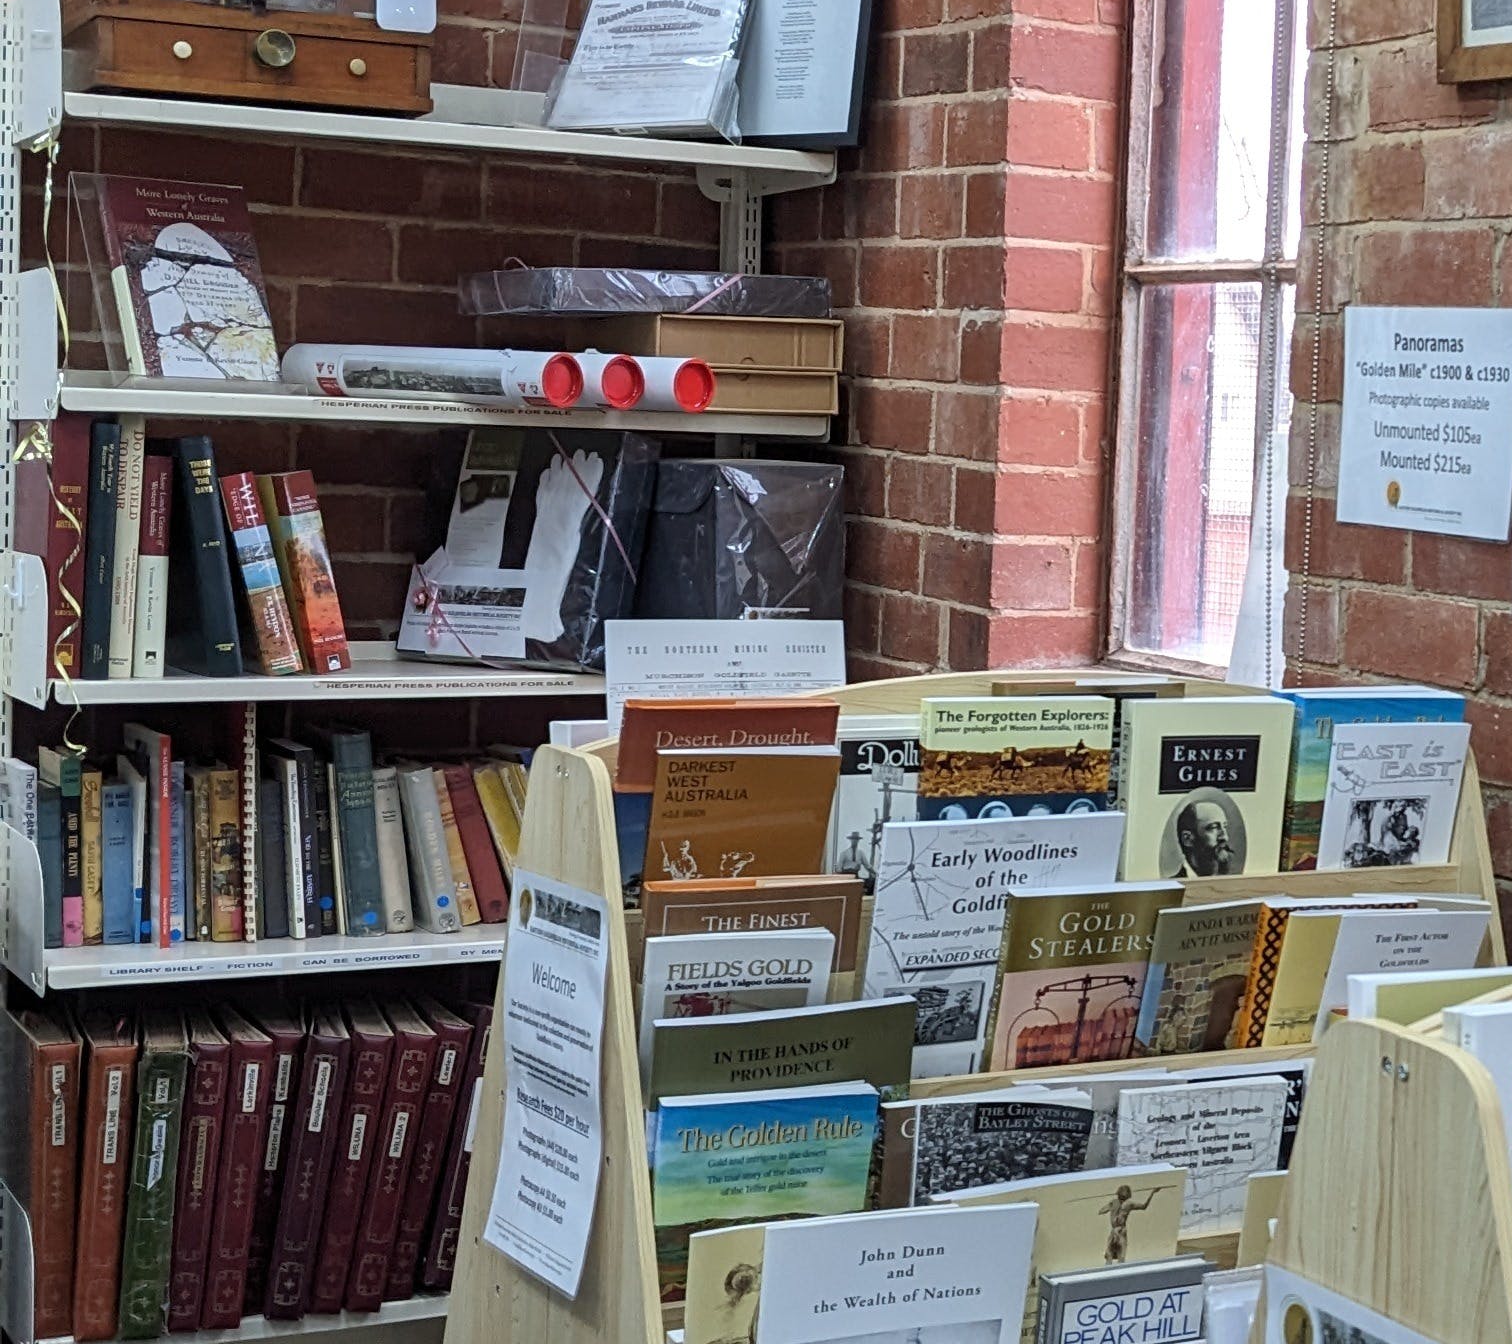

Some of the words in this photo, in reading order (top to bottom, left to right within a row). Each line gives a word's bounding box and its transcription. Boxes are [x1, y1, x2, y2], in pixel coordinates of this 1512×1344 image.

[147, 208, 184, 219] Western
[1394, 333, 1464, 352] Panoramas
[1430, 366, 1461, 380] c1900
[1466, 368, 1473, 380] &
[1478, 368, 1510, 382] c1930
[433, 406, 514, 415] PUBLICATIONS
[134, 431, 143, 454] DO
[1374, 421, 1439, 442] Unmounted
[1442, 424, 1480, 444] $105ea
[132, 456, 141, 482] NOT
[1380, 451, 1430, 472] Mounted
[1434, 454, 1471, 475] $215ea
[117, 455, 127, 510] DESPAIR
[130, 485, 139, 520] YIELD
[936, 710, 963, 722] The
[968, 710, 1036, 724] Forgotten
[1041, 709, 1109, 722] Explorers:
[1172, 745, 1247, 762] ERNEST
[669, 760, 736, 774] DARKEST
[1179, 766, 1238, 781] GILES
[668, 776, 709, 788] WEST
[664, 789, 749, 802] AUSTRALIA
[1060, 911, 1136, 934] GOLD
[1029, 934, 1153, 960] STEALERS
[109, 967, 161, 975] LIBRARY
[227, 962, 273, 970] FICTION
[355, 953, 420, 962] BORROWED
[668, 960, 742, 981] FIELDS
[748, 958, 813, 977] GOLD
[713, 1051, 734, 1064] IN
[738, 1048, 770, 1063] THE
[775, 1042, 828, 1059] HANDS
[832, 1037, 853, 1050] OF
[730, 1059, 834, 1082] PROVIDENCE
[979, 1106, 1005, 1117] THE
[1008, 1104, 1058, 1117] GHOSTS
[1063, 1109, 1079, 1119] OF
[978, 1116, 1030, 1130] BAYLEY
[1034, 1116, 1086, 1130] STREET
[678, 1127, 722, 1153] The
[729, 1121, 807, 1148] Golden
[814, 1116, 862, 1140] Rule
[859, 1248, 896, 1266] John
[902, 1244, 945, 1259] Dunn
[887, 1264, 915, 1279] and
[813, 1298, 838, 1314] the
[844, 1292, 897, 1309] Wealth
[902, 1288, 918, 1303] of
[923, 1284, 982, 1299] Nations
[1077, 1297, 1153, 1328] GOLD
[1159, 1292, 1190, 1316] AT
[1143, 1314, 1198, 1340] HILL
